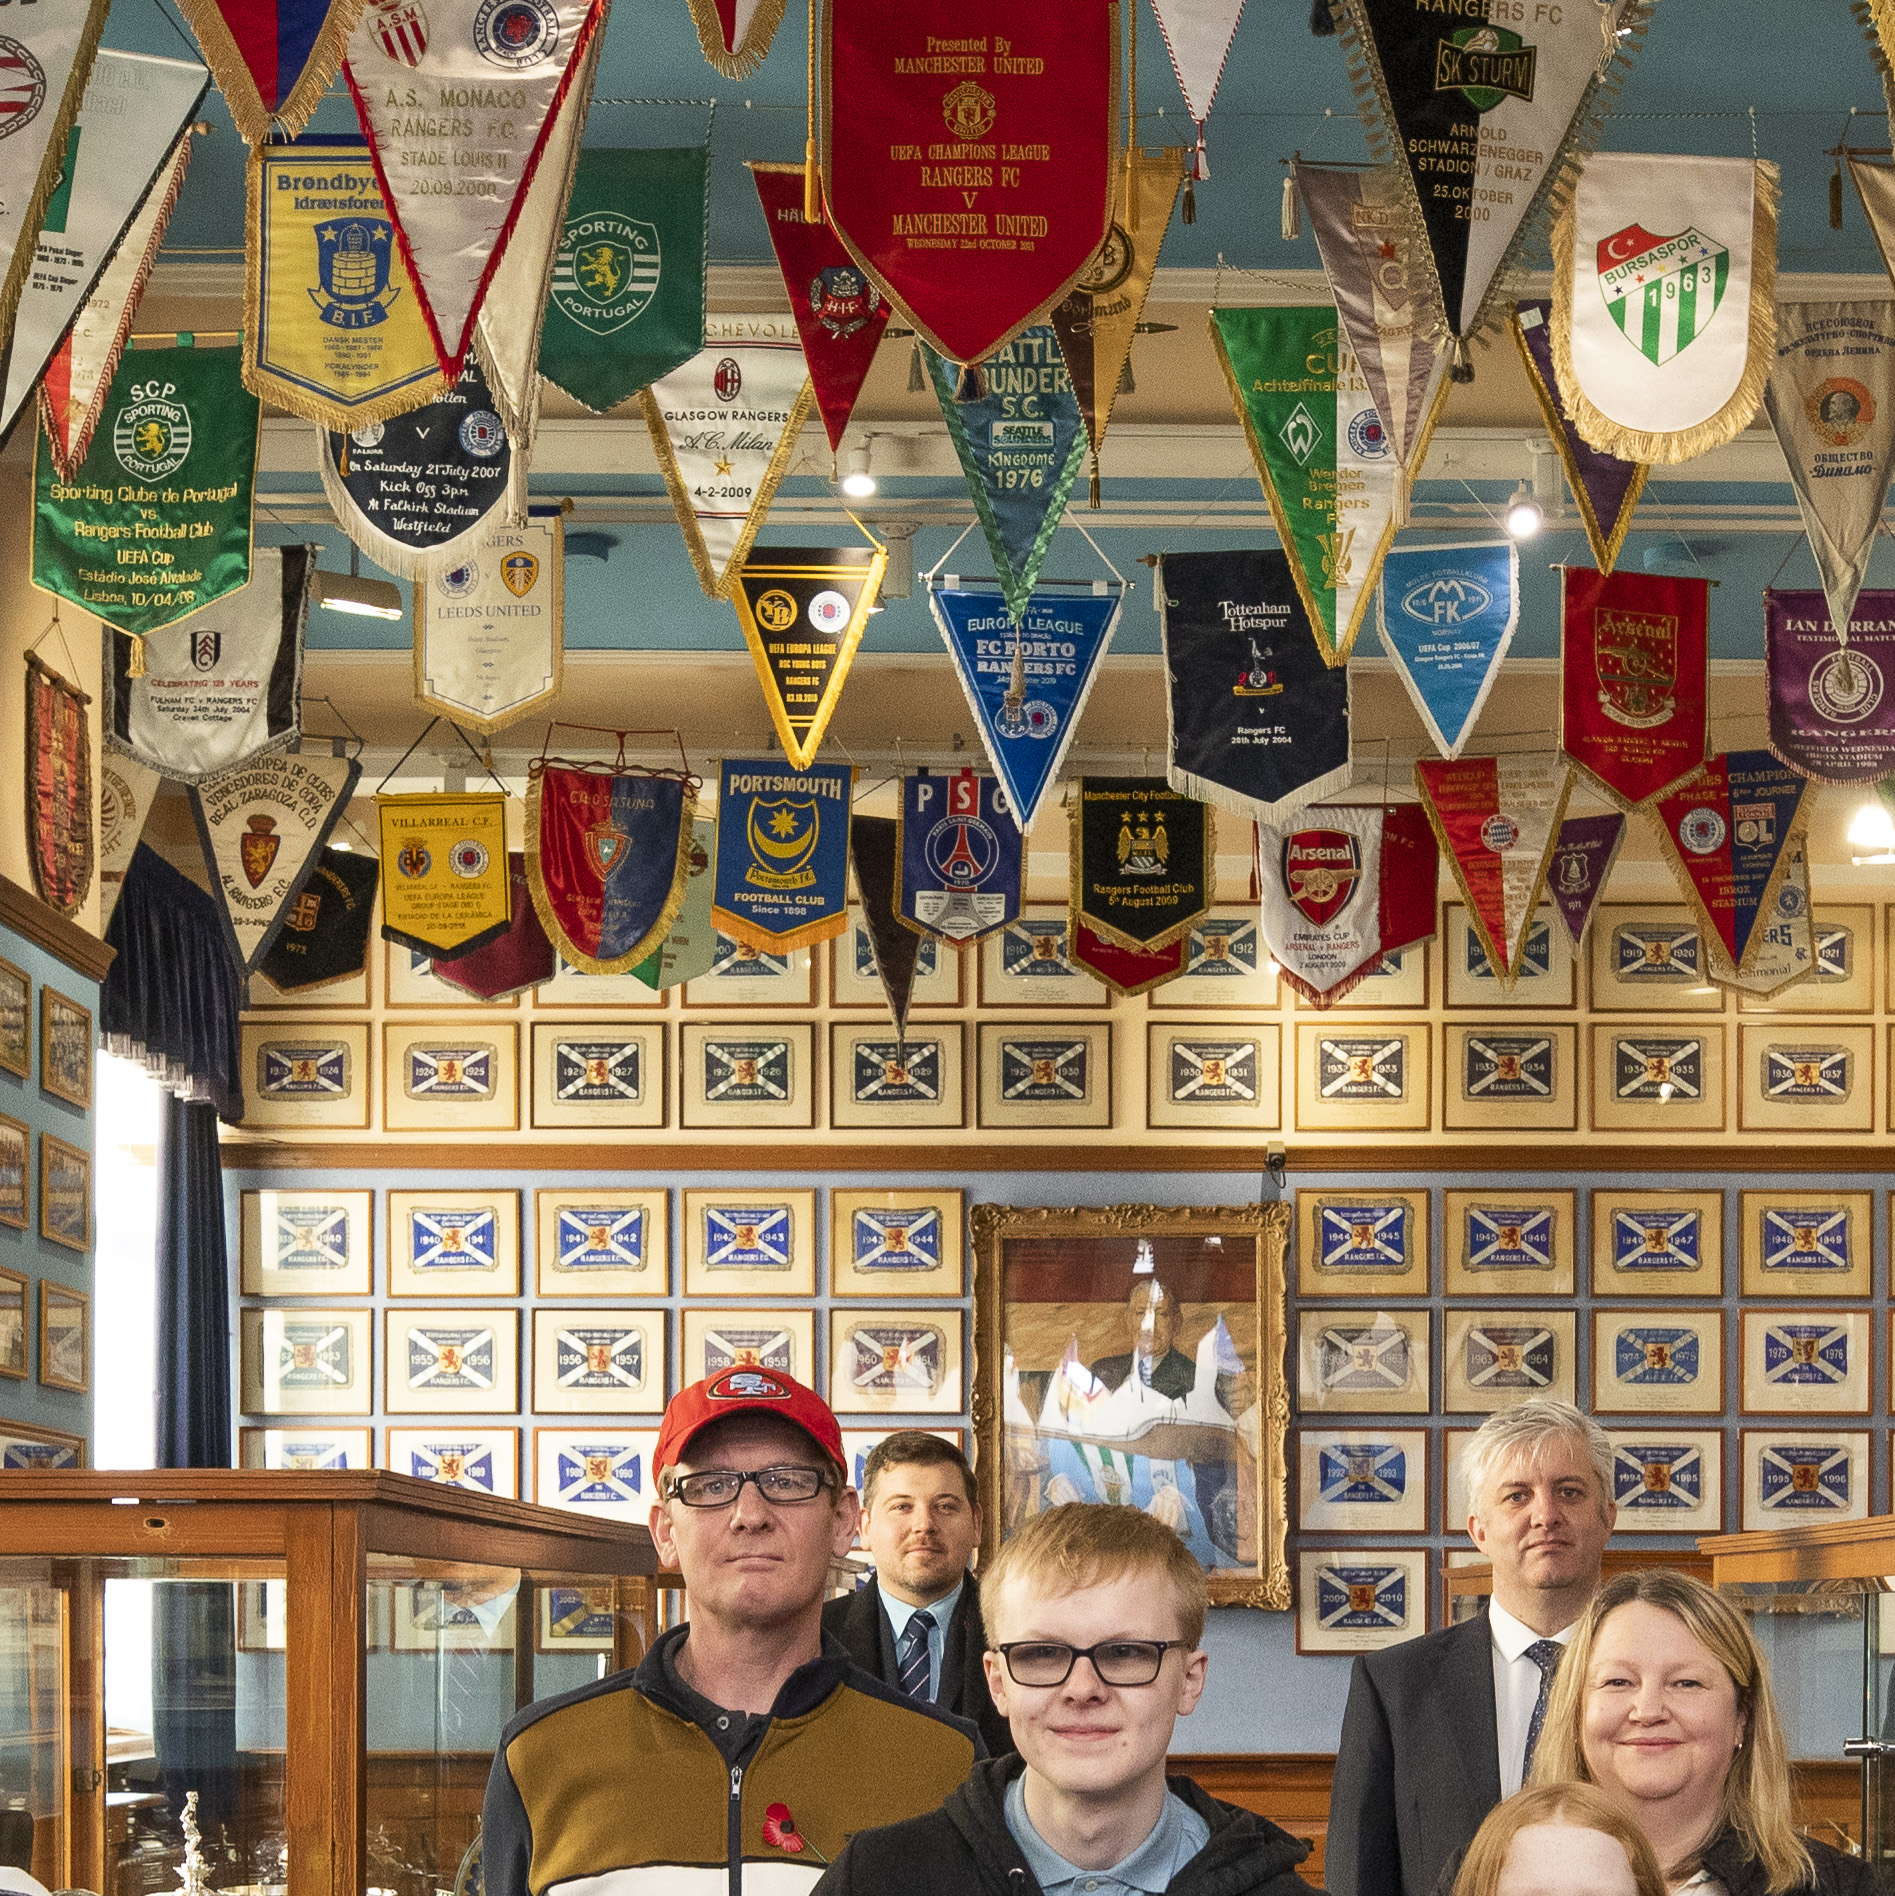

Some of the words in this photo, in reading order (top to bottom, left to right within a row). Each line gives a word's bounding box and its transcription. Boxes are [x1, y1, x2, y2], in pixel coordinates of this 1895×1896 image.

[927, 37, 988, 53] Presented
[995, 37, 1011, 56] By
[894, 56, 986, 74] MANCHESTER
[994, 56, 1044, 75] UNITED
[1439, 49, 1463, 83] SK
[1468, 49, 1530, 88] STURM
[386, 89, 423, 109] A.S.
[440, 88, 527, 110] MONACO
[391, 117, 472, 138] RANGERS
[486, 120, 519, 139] F.C.
[1449, 123, 1507, 142] ARNOLD
[401, 150, 449, 167] STADE
[453, 149, 492, 169] LOUIS
[891, 144, 923, 161] UEFA
[928, 144, 997, 161] CHAMPIONS
[1002, 144, 1050, 161] LEAGUE
[1408, 139, 1543, 165] SCHWARZENEGGER
[921, 166, 993, 188] RANGERS
[1002, 168, 1020, 187] FC
[1418, 157, 1480, 175] STADION
[1494, 163, 1532, 183] GRAZ
[410, 179, 497, 197] 20.09.2000
[1433, 184, 1514, 205] 25.OKTOBER
[963, 191, 976, 209] V
[1454, 205, 1491, 222] 2000
[892, 215, 989, 235] MANCHESTER
[994, 215, 1048, 237] UNITED
[559, 223, 649, 251] SPORTING
[907, 239, 957, 249] WEDNESDAY
[979, 240, 1017, 251] OCTOBER
[1604, 234, 1700, 287] BURSASPOR
[1647, 263, 1713, 308] 1963
[564, 296, 644, 320] PORTUGAL
[130, 381, 176, 401] SCP
[123, 404, 181, 424] SPORTING
[665, 409, 728, 422] GLASGOW
[732, 410, 789, 423] RANGERS
[1001, 397, 1045, 418] S.C.
[685, 431, 720, 451] A.C.
[725, 432, 773, 451] Milan
[122, 454, 181, 475] PORTUGAL
[987, 453, 1054, 468] KINGDOME
[1815, 452, 1873, 462] ОБЩЕСТВО
[365, 461, 422, 477] Saturday
[471, 468, 501, 477] 2007
[996, 470, 1043, 488] 1976
[50, 483, 113, 504] Sporting
[118, 485, 158, 501] Clube
[161, 487, 179, 501] de
[183, 482, 238, 503] Portugal
[381, 481, 411, 492] Kick
[416, 482, 436, 498] Off
[694, 486, 751, 499] 4-2-2009
[384, 500, 429, 513] Falkirk
[434, 504, 479, 516] Stadium
[1303, 497, 1370, 512] Rangers
[141, 508, 156, 520] vs
[74, 523, 131, 541] Rangers
[135, 522, 184, 538] Football
[189, 522, 214, 537] Club
[393, 518, 451, 536] Westfield
[117, 549, 149, 565] UEFA
[152, 551, 175, 567] Cup
[79, 569, 125, 584] Estádio
[129, 570, 157, 584] José
[160, 569, 202, 584] Alvalade
[84, 589, 127, 606] Lisboa,
[438, 605, 482, 619] LEEDS
[484, 604, 542, 619] UNITED
[1218, 600, 1291, 620] Tottenham
[1029, 618, 1084, 635] LEAGUE
[1229, 615, 1288, 631] Hotspur
[1785, 619, 1817, 631] IAN
[977, 640, 1001, 654] FC
[1005, 642, 1076, 657] PORTO
[1056, 664, 1076, 675] FC
[1238, 725, 1272, 737] Rangers
[1275, 726, 1286, 735] FC
[729, 773, 842, 800] PORTSMOUTH
[392, 818, 462, 828] VILLARREAL
[1290, 845, 1351, 860] Arsenal
[1093, 884, 1131, 896] Rangers
[1134, 885, 1170, 894] Football
[1172, 884, 1194, 893] Club
[735, 893, 791, 906] FOOTBALL
[795, 894, 825, 907] CLUB
[1122, 897, 1153, 908] August
[1156, 896, 1179, 906] 2009
[752, 904, 781, 915] Since
[784, 906, 807, 916] 1898
[1294, 933, 1331, 941] EMIRATES
[1232, 943, 1254, 955] 1912
[1285, 943, 1316, 951] ARSENAL
[1327, 941, 1360, 950] RANGERS
[1623, 948, 1643, 959] 1919
[1673, 948, 1695, 959] 1920
[1327, 1064, 1349, 1073] 1932
[614, 1233, 637, 1243] 1942
[411, 1355, 434, 1365] 1955
[467, 1355, 490, 1365] 1956
[1769, 1349, 1787, 1358] 1975
[1826, 1349, 1844, 1359] 1976
[1323, 1592, 1346, 1604] 2009
[1379, 1592, 1403, 1604] 2010
